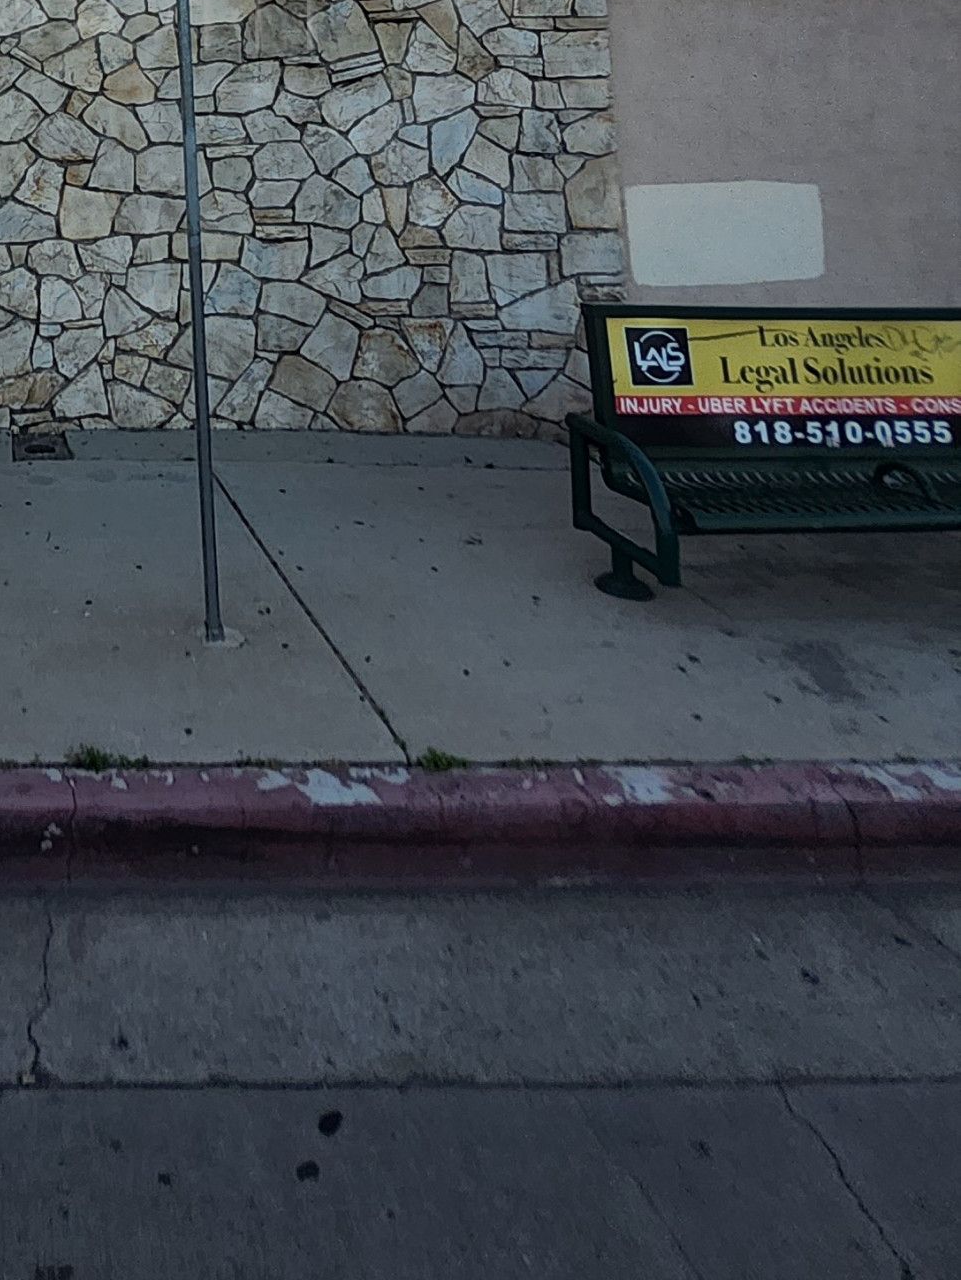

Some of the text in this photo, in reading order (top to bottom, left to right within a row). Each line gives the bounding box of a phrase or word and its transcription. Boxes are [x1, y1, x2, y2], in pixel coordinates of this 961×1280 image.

[758, 325, 800, 348] Los
[803, 325, 888, 355] Angeles
[720, 356, 934, 393] Legal Solutions
[619, 397, 684, 414] INJURY
[697, 397, 748, 414] UBER
[750, 397, 796, 414] LYFT
[799, 398, 897, 415] ACCIDENTS
[733, 420, 952, 446] 818-510-0555
